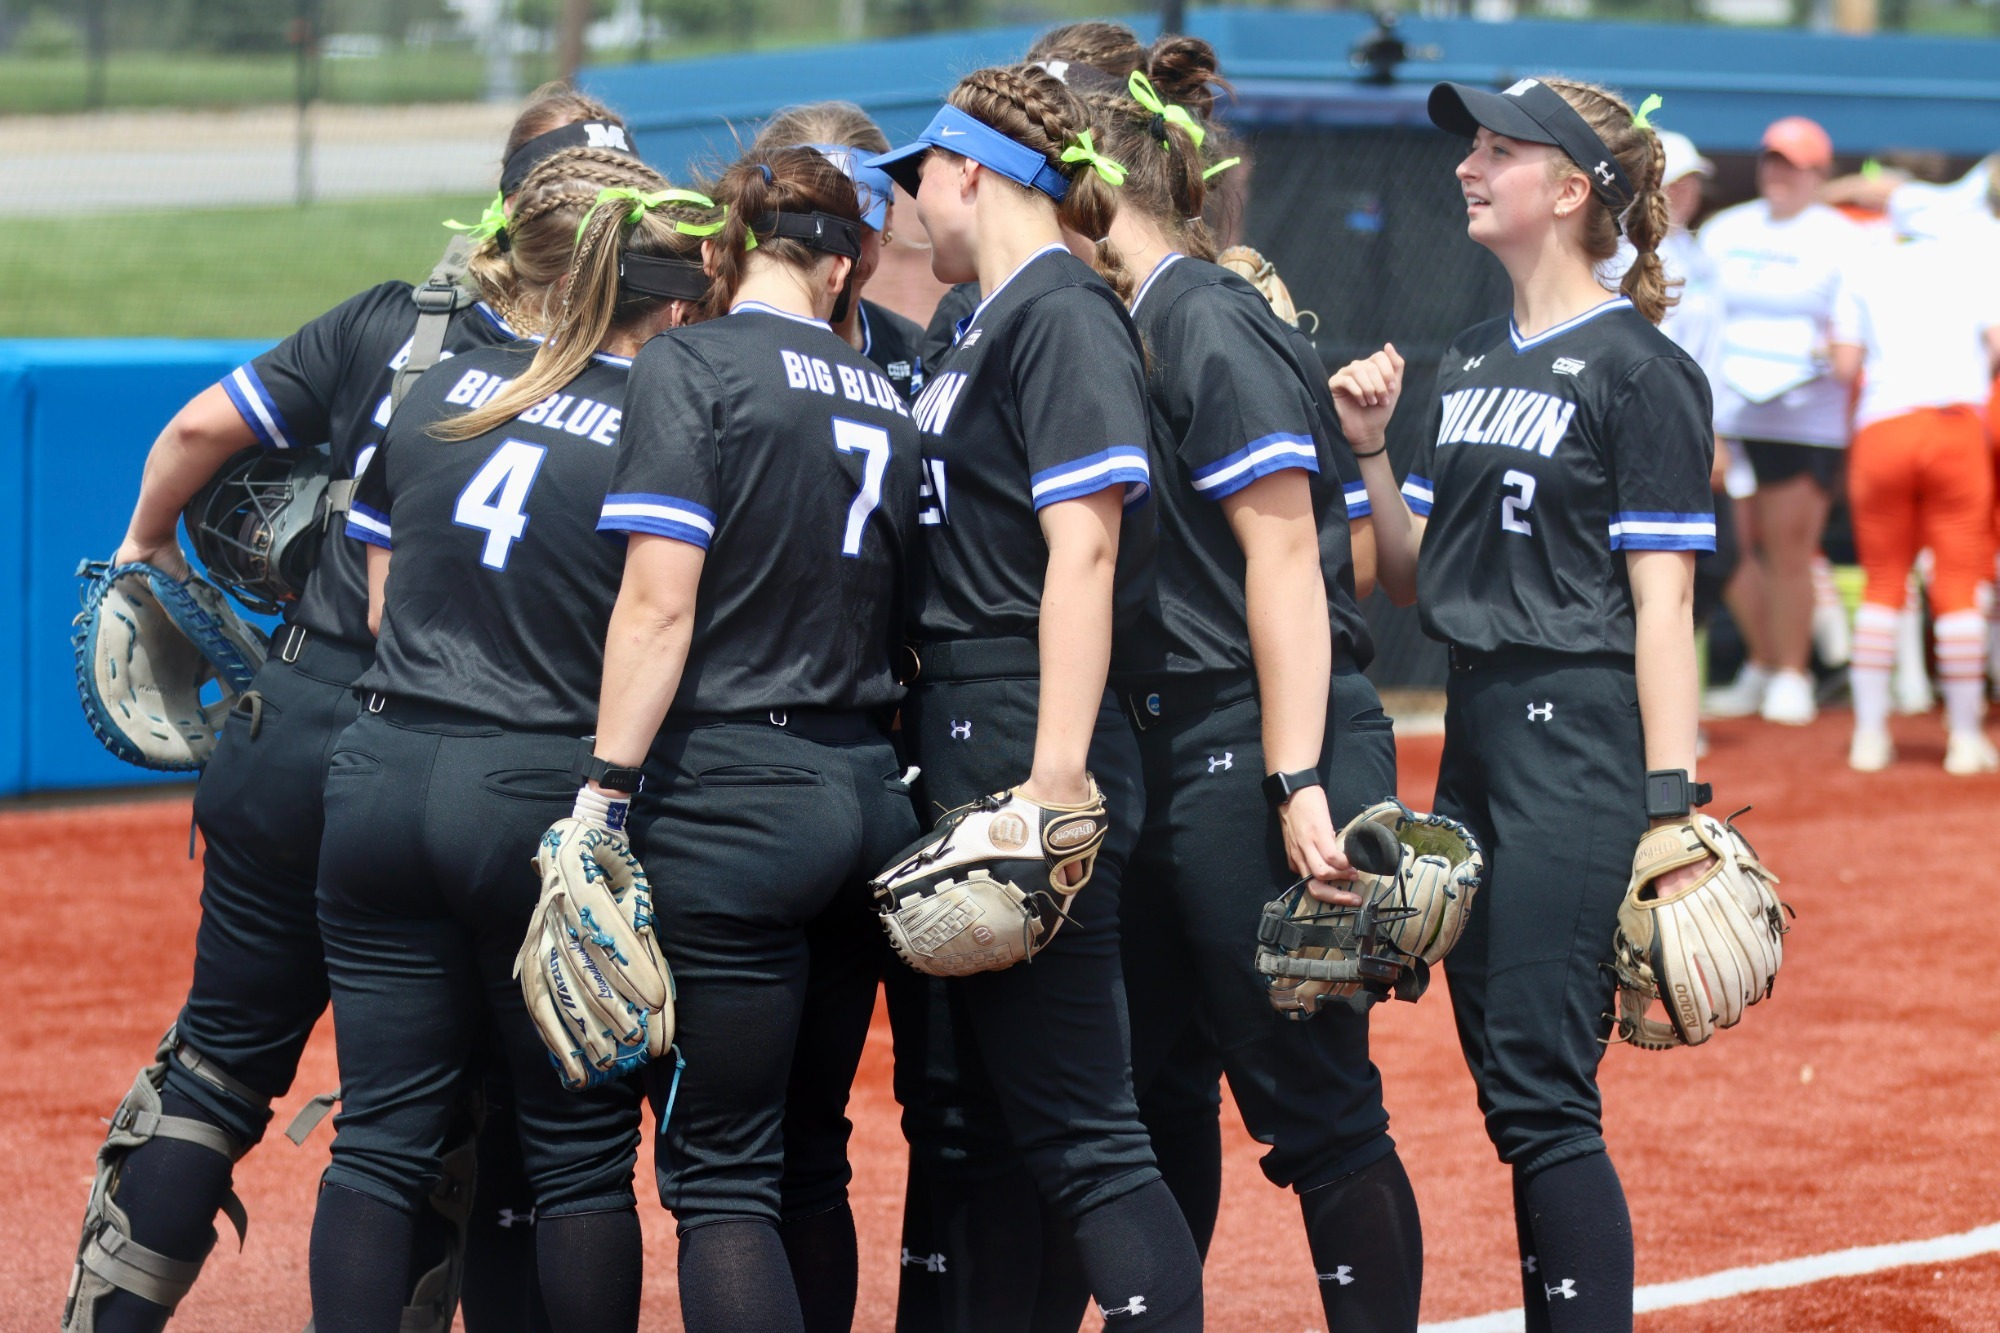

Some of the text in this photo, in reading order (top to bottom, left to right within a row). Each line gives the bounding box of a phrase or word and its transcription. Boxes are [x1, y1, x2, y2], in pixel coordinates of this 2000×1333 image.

[583, 123, 630, 152] M
[780, 350, 910, 419] BIG BLUE
[517, 391, 623, 447] BLUE
[452, 437, 548, 572] 4
[831, 415, 893, 559] 7
[1501, 469, 1537, 537] 2
[1673, 983, 1699, 1029] A2000
